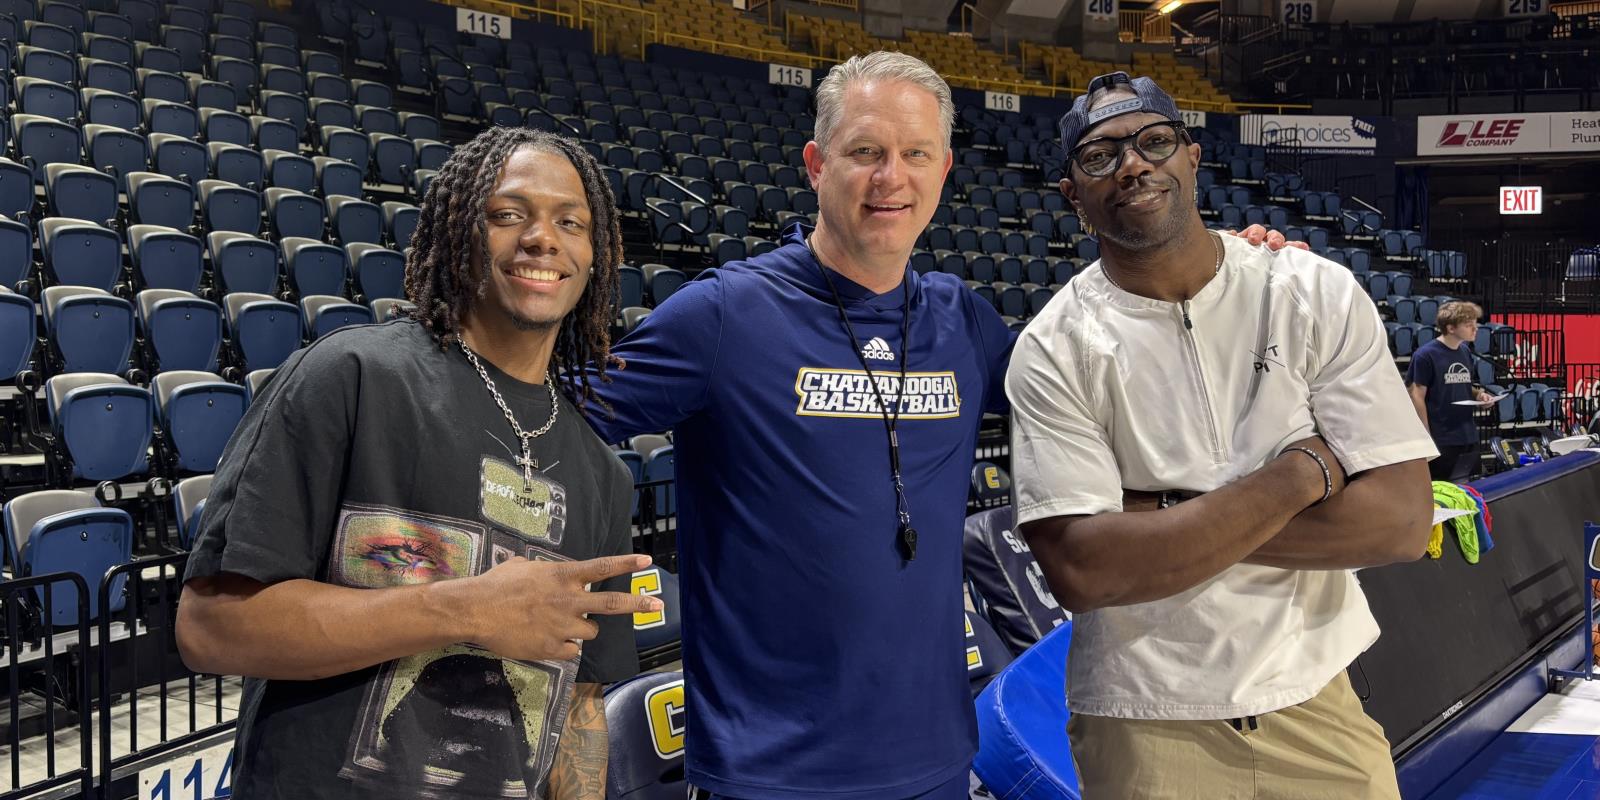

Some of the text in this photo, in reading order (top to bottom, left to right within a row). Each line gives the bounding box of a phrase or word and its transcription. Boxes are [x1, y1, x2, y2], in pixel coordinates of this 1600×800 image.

[1088, 0, 1113, 14] 218
[1285, 3, 1313, 24] 219
[467, 13, 500, 35] 115
[777, 67, 803, 85] 115
[992, 94, 1014, 109] 116
[1470, 119, 1526, 138] LEE
[1466, 138, 1516, 147] COMPANY
[1503, 189, 1539, 211] EXIT
[861, 349, 895, 361] adidas
[802, 372, 954, 395] CHATTANOOGA
[805, 391, 958, 413] BASKETBALL
[151, 748, 234, 800] 114
